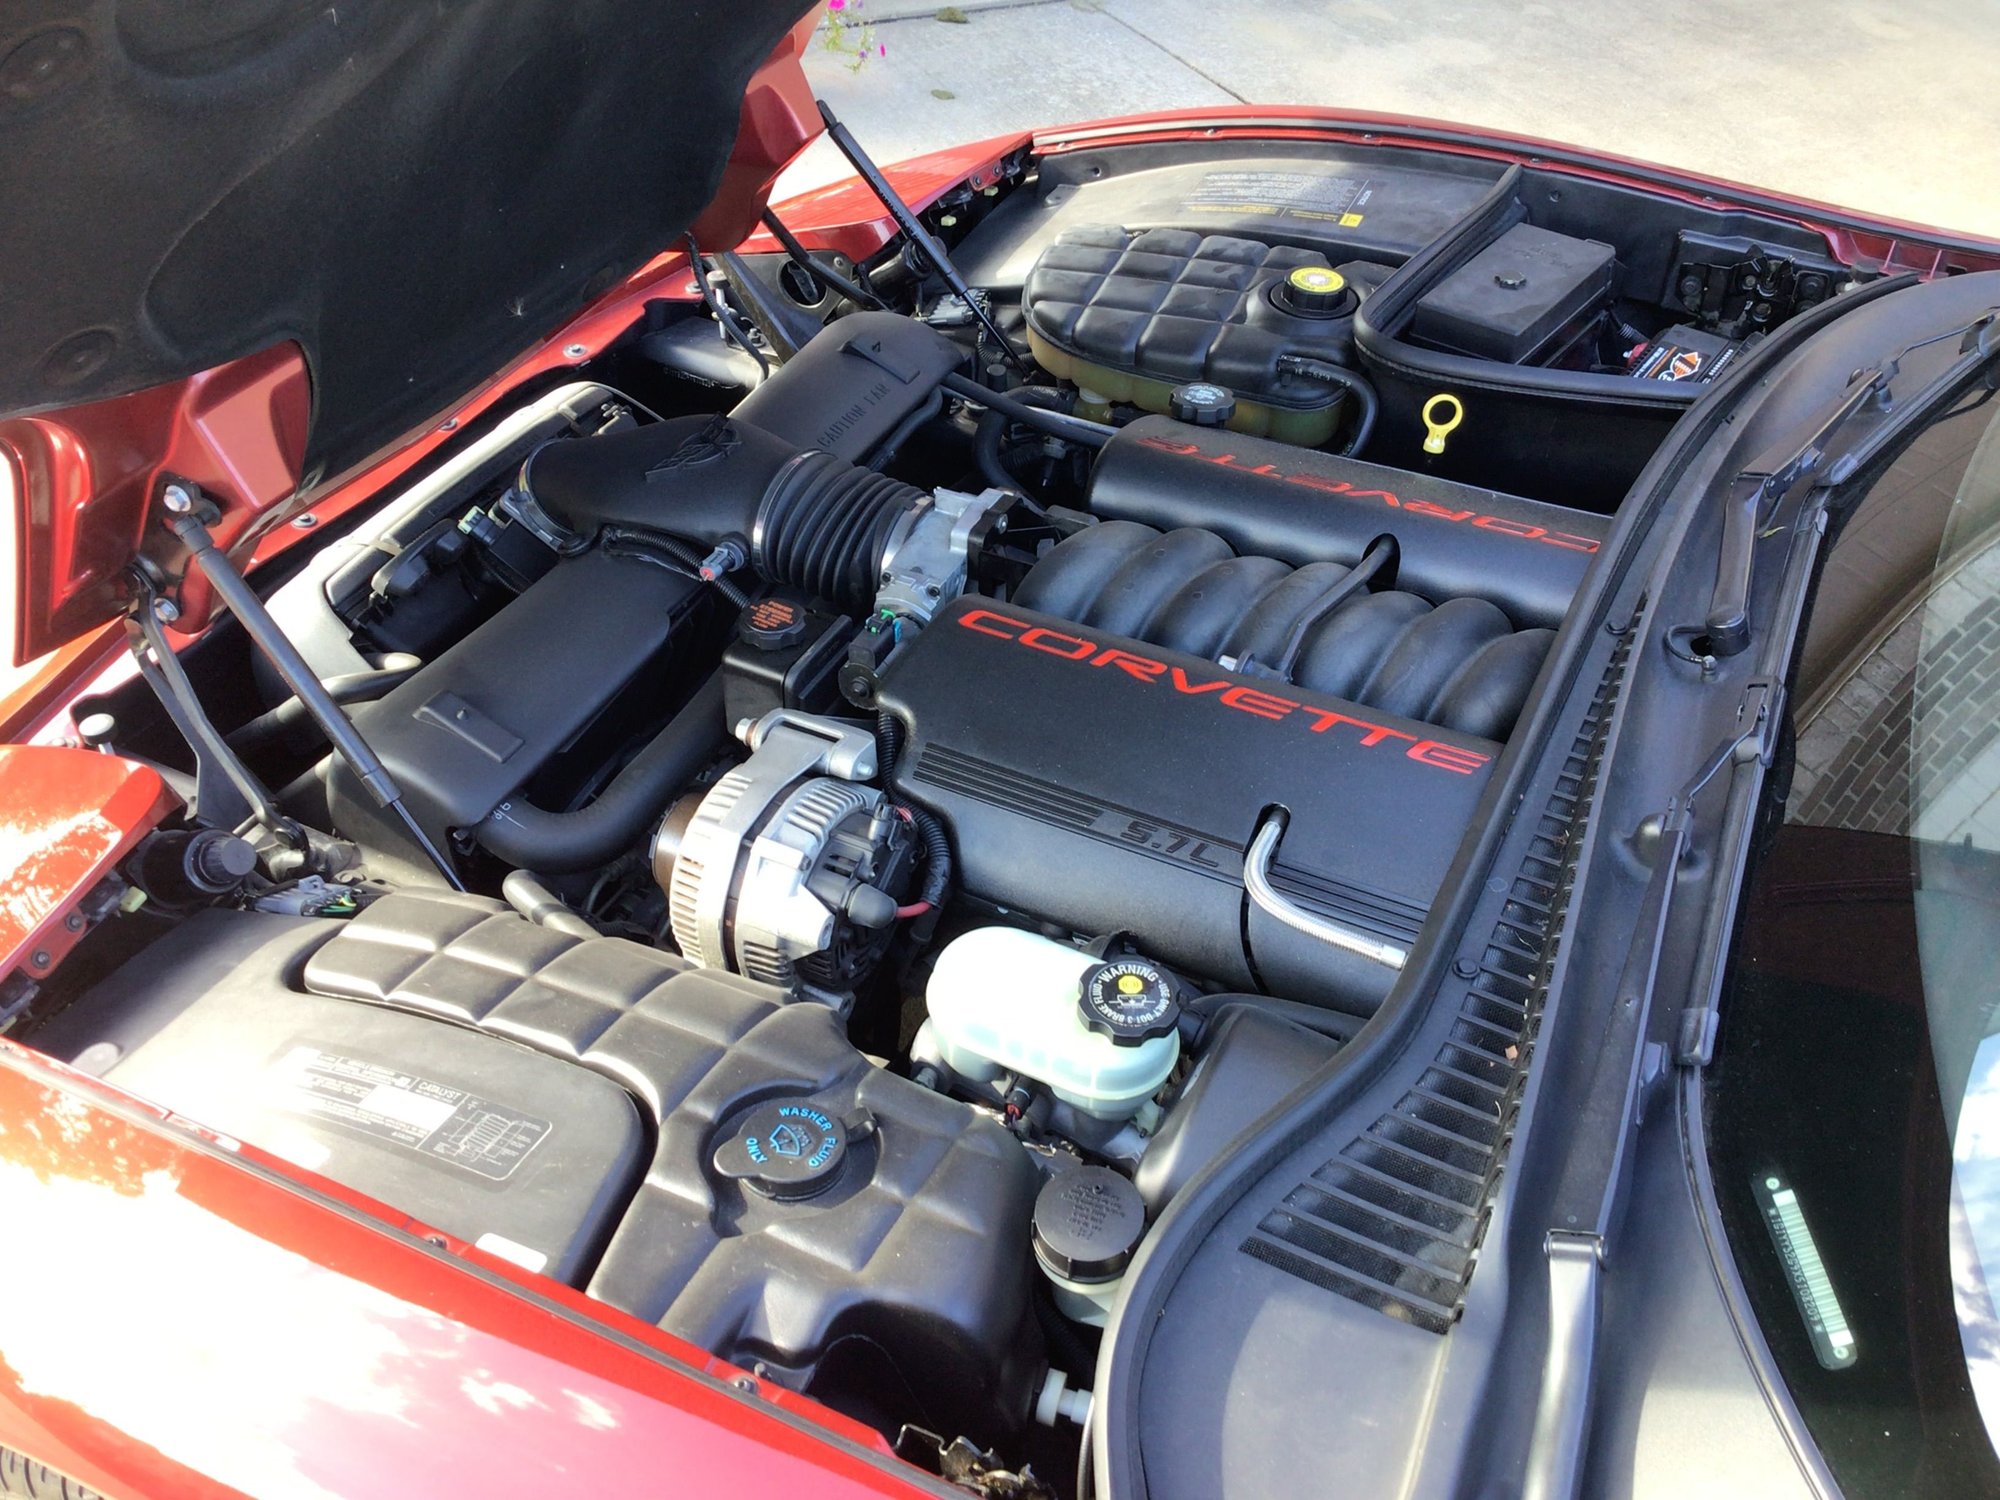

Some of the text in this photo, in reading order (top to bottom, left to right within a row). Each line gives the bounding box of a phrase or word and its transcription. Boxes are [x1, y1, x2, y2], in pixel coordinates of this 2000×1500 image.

[816, 404, 867, 448] CAUTION
[1137, 434, 1602, 553] CORVETTE
[957, 608, 1491, 775] CORVETTE
[1120, 818, 1220, 868] 5.7L
[1098, 964, 1159, 983] WARNING
[1092, 983, 1104, 1004] FLUID
[1098, 1003, 1123, 1023] BRAKE
[1137, 1013, 1154, 1024] DOT
[417, 1081, 462, 1101] CATALYST
[745, 1106, 837, 1168] WASHER FLUID ONLY
